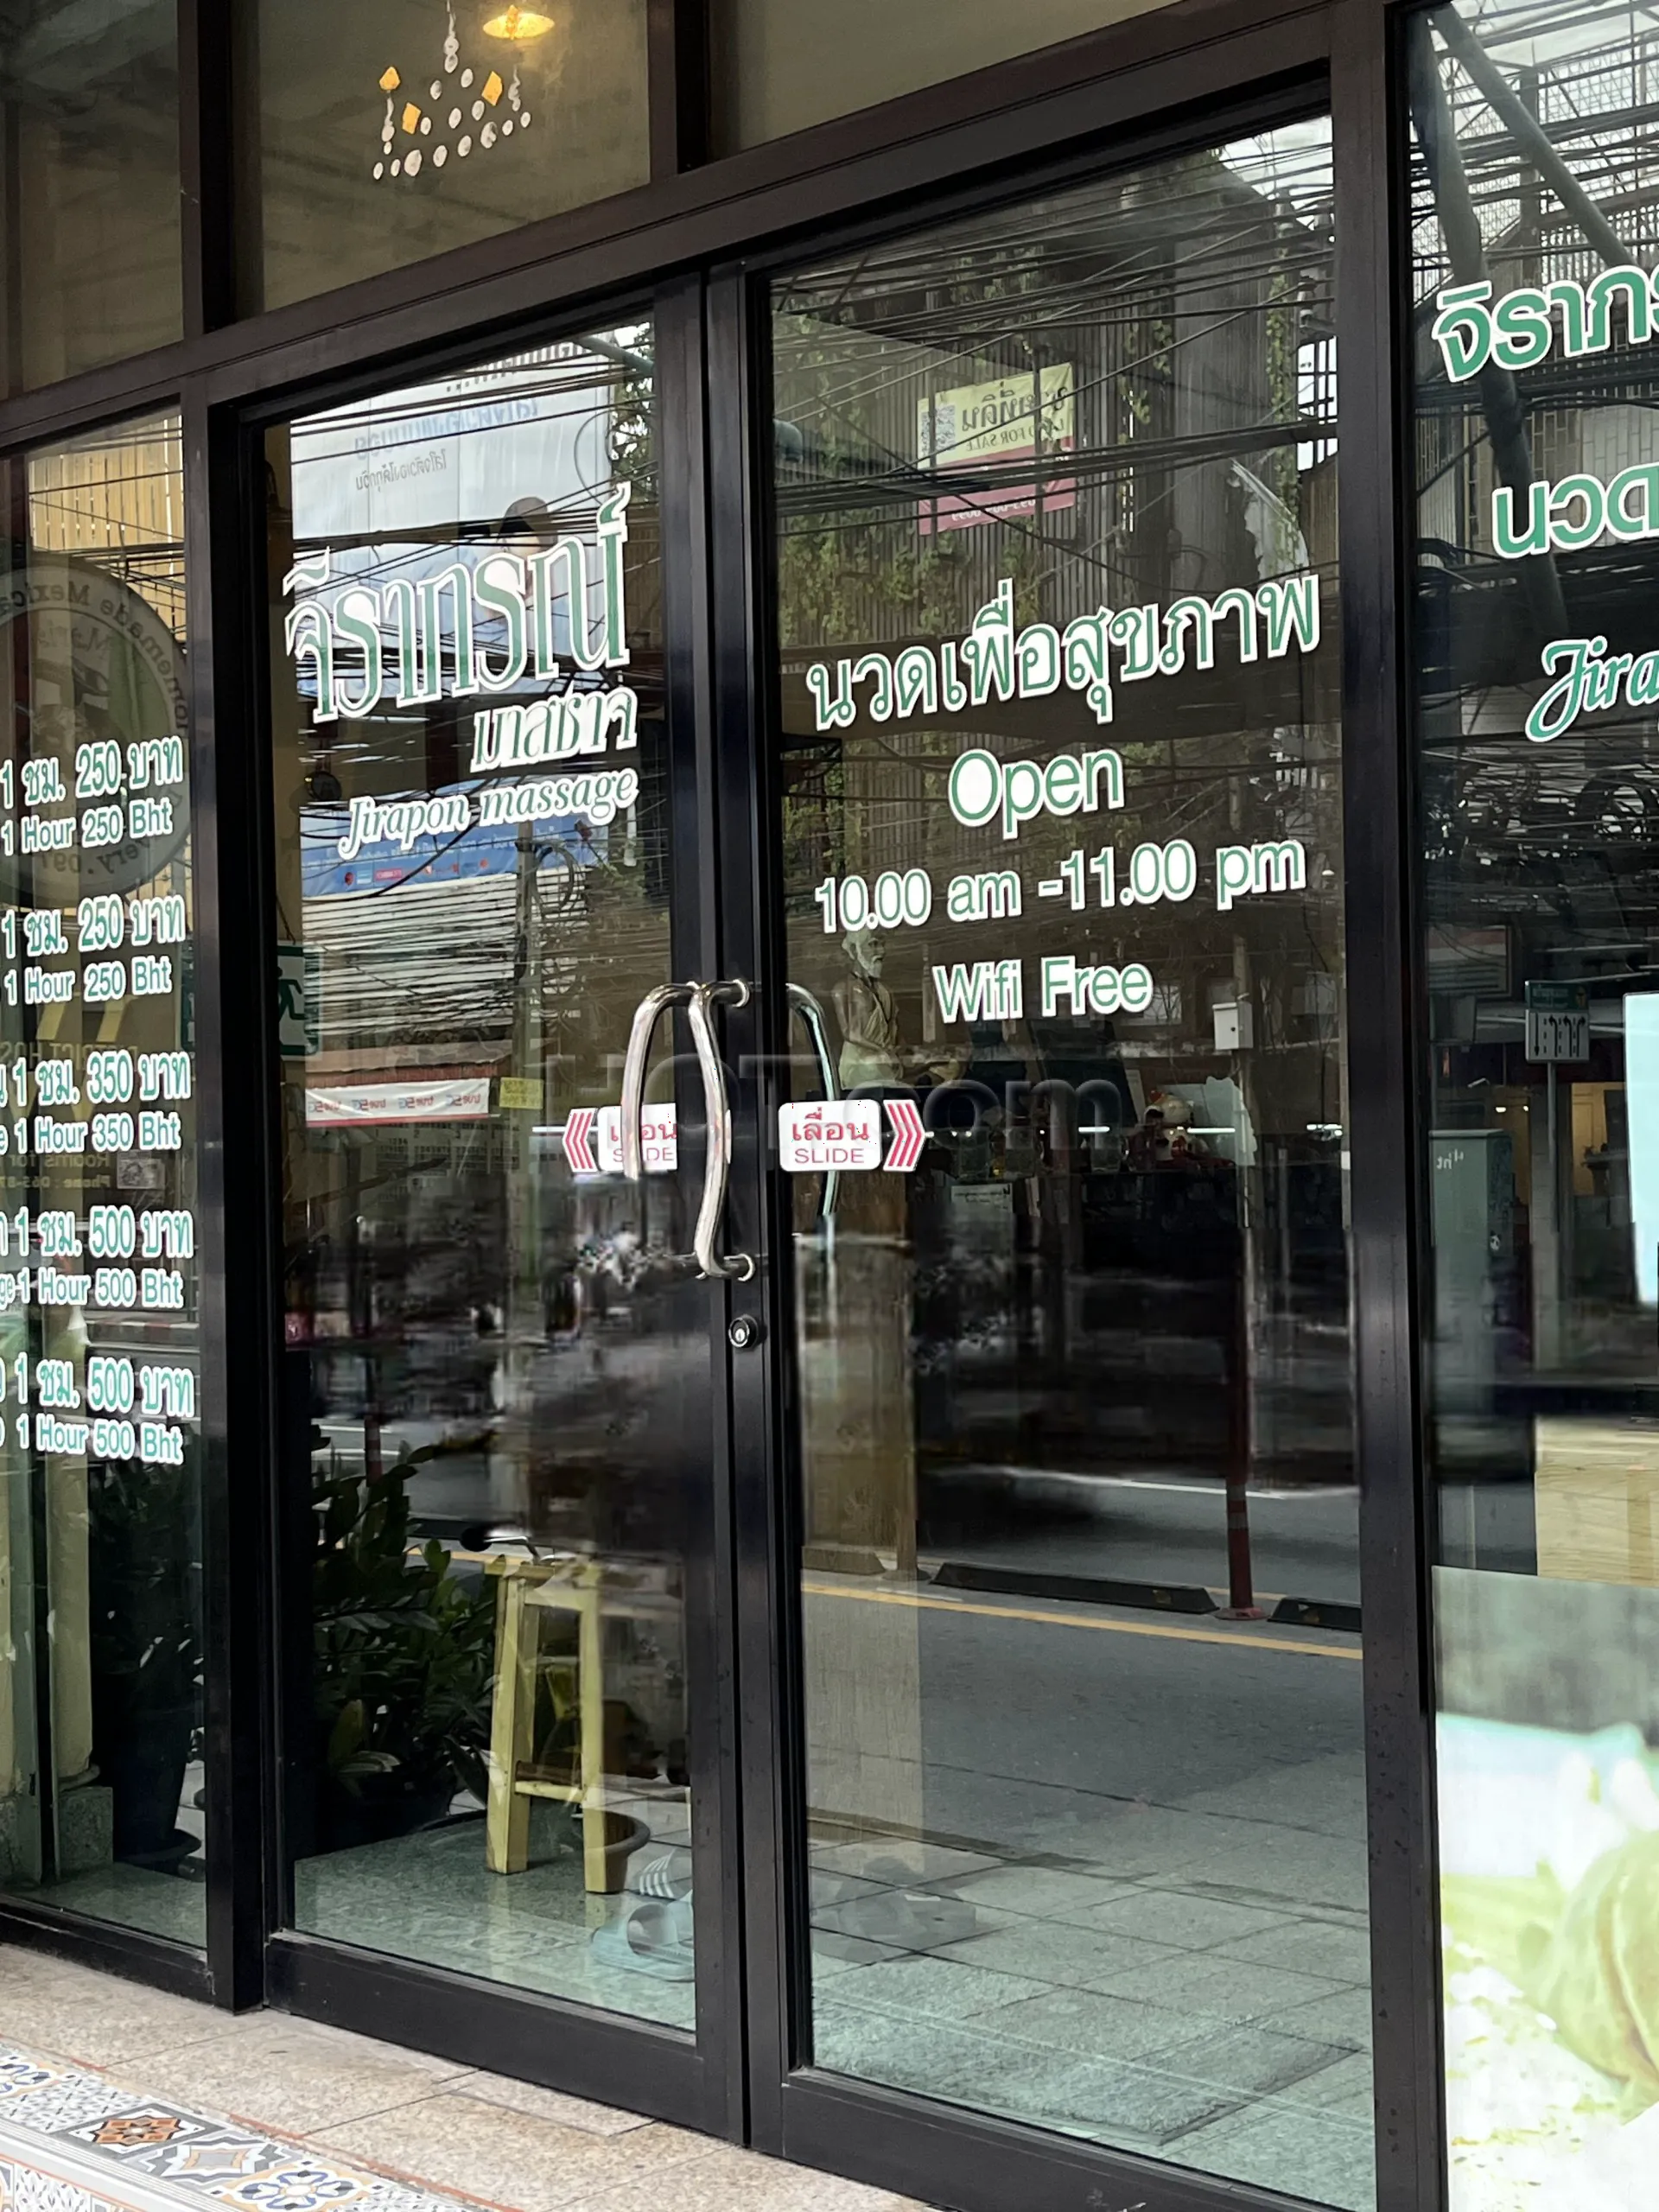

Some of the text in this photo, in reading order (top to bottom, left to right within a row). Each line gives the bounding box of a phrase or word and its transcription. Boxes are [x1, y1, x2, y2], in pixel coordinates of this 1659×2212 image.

[1432, 264, 1659, 383] จิราภ
[806, 576, 1320, 731] นวดเพื่อสุขภาพ
[1525, 635, 1659, 743] Jira
[0, 735, 183, 809] 1 ชม. 250 บาท
[949, 748, 1124, 839] Open
[1, 797, 173, 855] 1 Hour 250 Bht
[338, 796, 471, 860] Jirapon
[480, 768, 639, 826] massage
[815, 868, 932, 933] 10.00
[948, 870, 1022, 923] am
[1216, 840, 1306, 911] pm
[2, 893, 186, 958] 1 ชม. 250 บาท
[4, 956, 172, 1005] 1 Hour 250 Bht
[932, 956, 1154, 1024] Wifi Free
[12, 1057, 27, 1107] 1
[35, 1059, 80, 1106] ชม.
[87, 1049, 134, 1103] 350
[138, 1052, 192, 1100] บาท
[14, 1117, 27, 1154] 1
[35, 1116, 88, 1154] Hour
[92, 1112, 134, 1152] 350
[139, 1111, 181, 1150] Bht
[613, 1147, 675, 1162] SDE
[791, 1107, 869, 1141] เลื่อน
[794, 1147, 865, 1164] SLIDE
[15, 1206, 29, 1256] 1
[37, 1211, 82, 1257] ชม.
[89, 1205, 136, 1259] 500
[140, 1210, 194, 1259] บาท
[17, 1267, 30, 1304] 1
[38, 1267, 91, 1306] Hour
[95, 1268, 137, 1307] 500
[142, 1268, 184, 1308] Bht
[14, 1351, 28, 1404] 1
[36, 1359, 80, 1408] ชม.
[87, 1357, 134, 1413] 500
[140, 1365, 194, 1418] บาท
[16, 1414, 29, 1449] 1
[35, 1413, 88, 1454] Hour
[93, 1418, 135, 1460] 500
[141, 1422, 183, 1465] Bht
